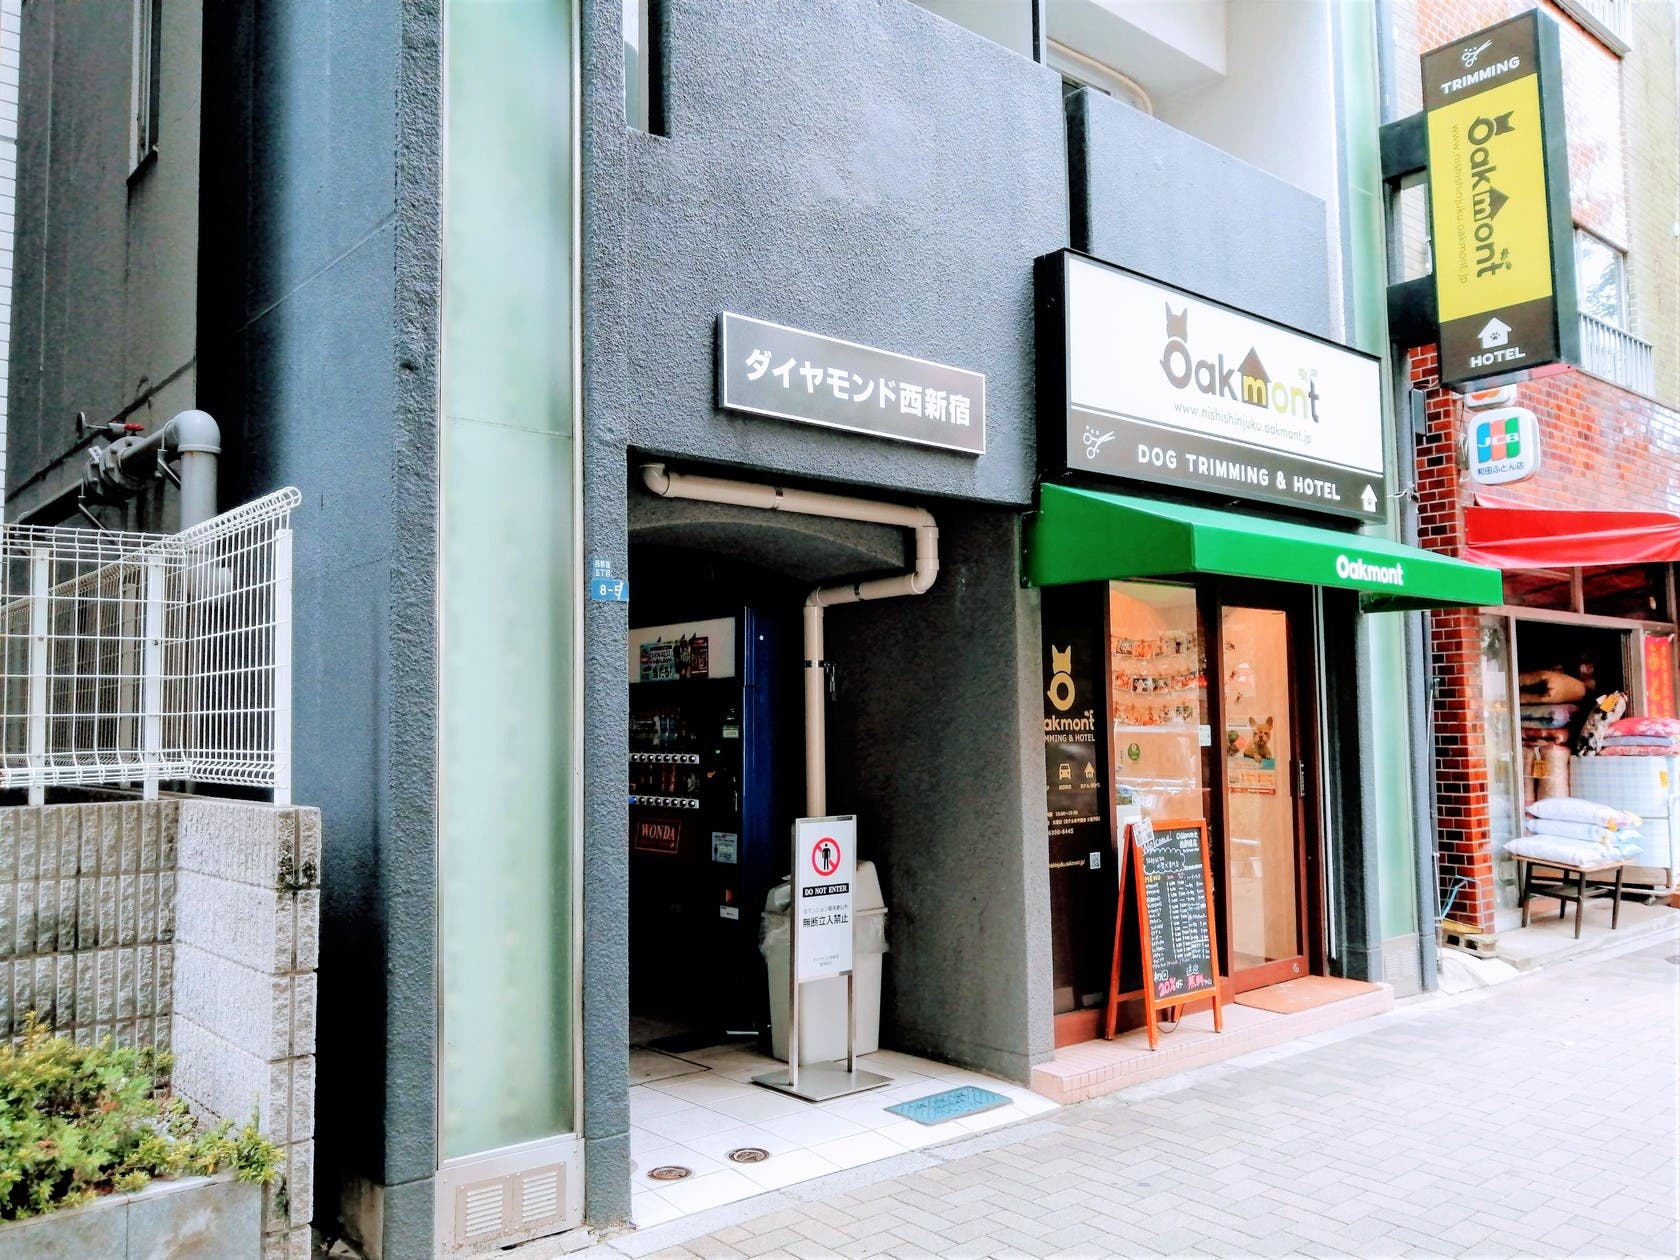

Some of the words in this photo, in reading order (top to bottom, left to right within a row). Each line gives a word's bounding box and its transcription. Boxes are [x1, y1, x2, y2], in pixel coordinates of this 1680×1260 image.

[1440, 56, 1520, 94] TRIMMING
[1468, 116, 1504, 278] Oakmont
[1470, 346, 1526, 368] HOTEL
[745, 349, 971, 427] ダイヤモンド西新宿
[1160, 336, 1320, 424] Oakmont
[1174, 401, 1312, 446] www.nishishinjuku.oakmont.jp
[1138, 444, 1178, 469] DOG
[1186, 454, 1269, 487] TRIMMING
[1277, 470, 1287, 490] &
[1293, 475, 1341, 501] HOTEL
[1336, 554, 1404, 586] Oakmont
[1069, 734, 1074, 742] &
[1075, 733, 1096, 742] HOTEL
[641, 823, 676, 841] WONDA
[804, 888, 814, 896] DO
[814, 886, 828, 895] NOT
[829, 885, 848, 894] ENTER
